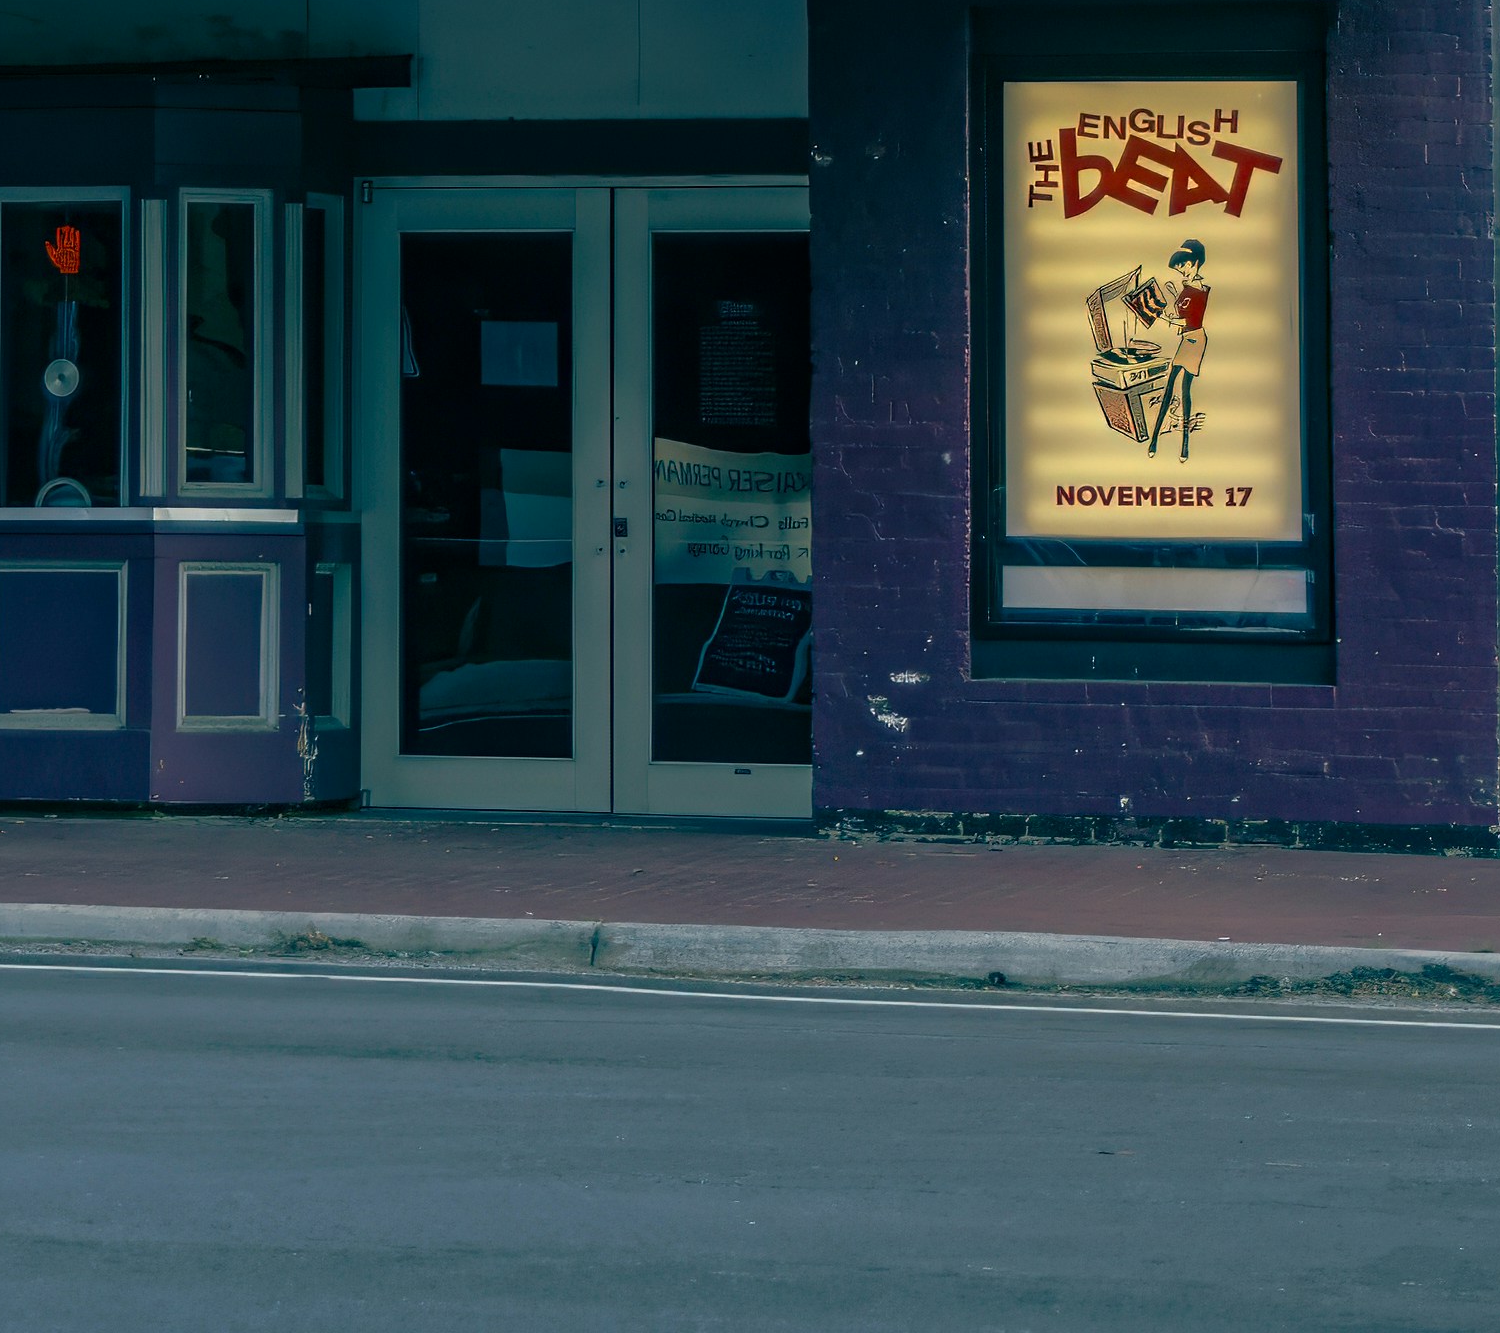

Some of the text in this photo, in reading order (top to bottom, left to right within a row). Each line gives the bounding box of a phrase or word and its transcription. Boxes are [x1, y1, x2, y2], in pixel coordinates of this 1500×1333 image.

[1077, 108, 1239, 146] ENGLISH
[1028, 139, 1059, 208] THE
[1056, 485, 1253, 507] NOVEMBER 17
